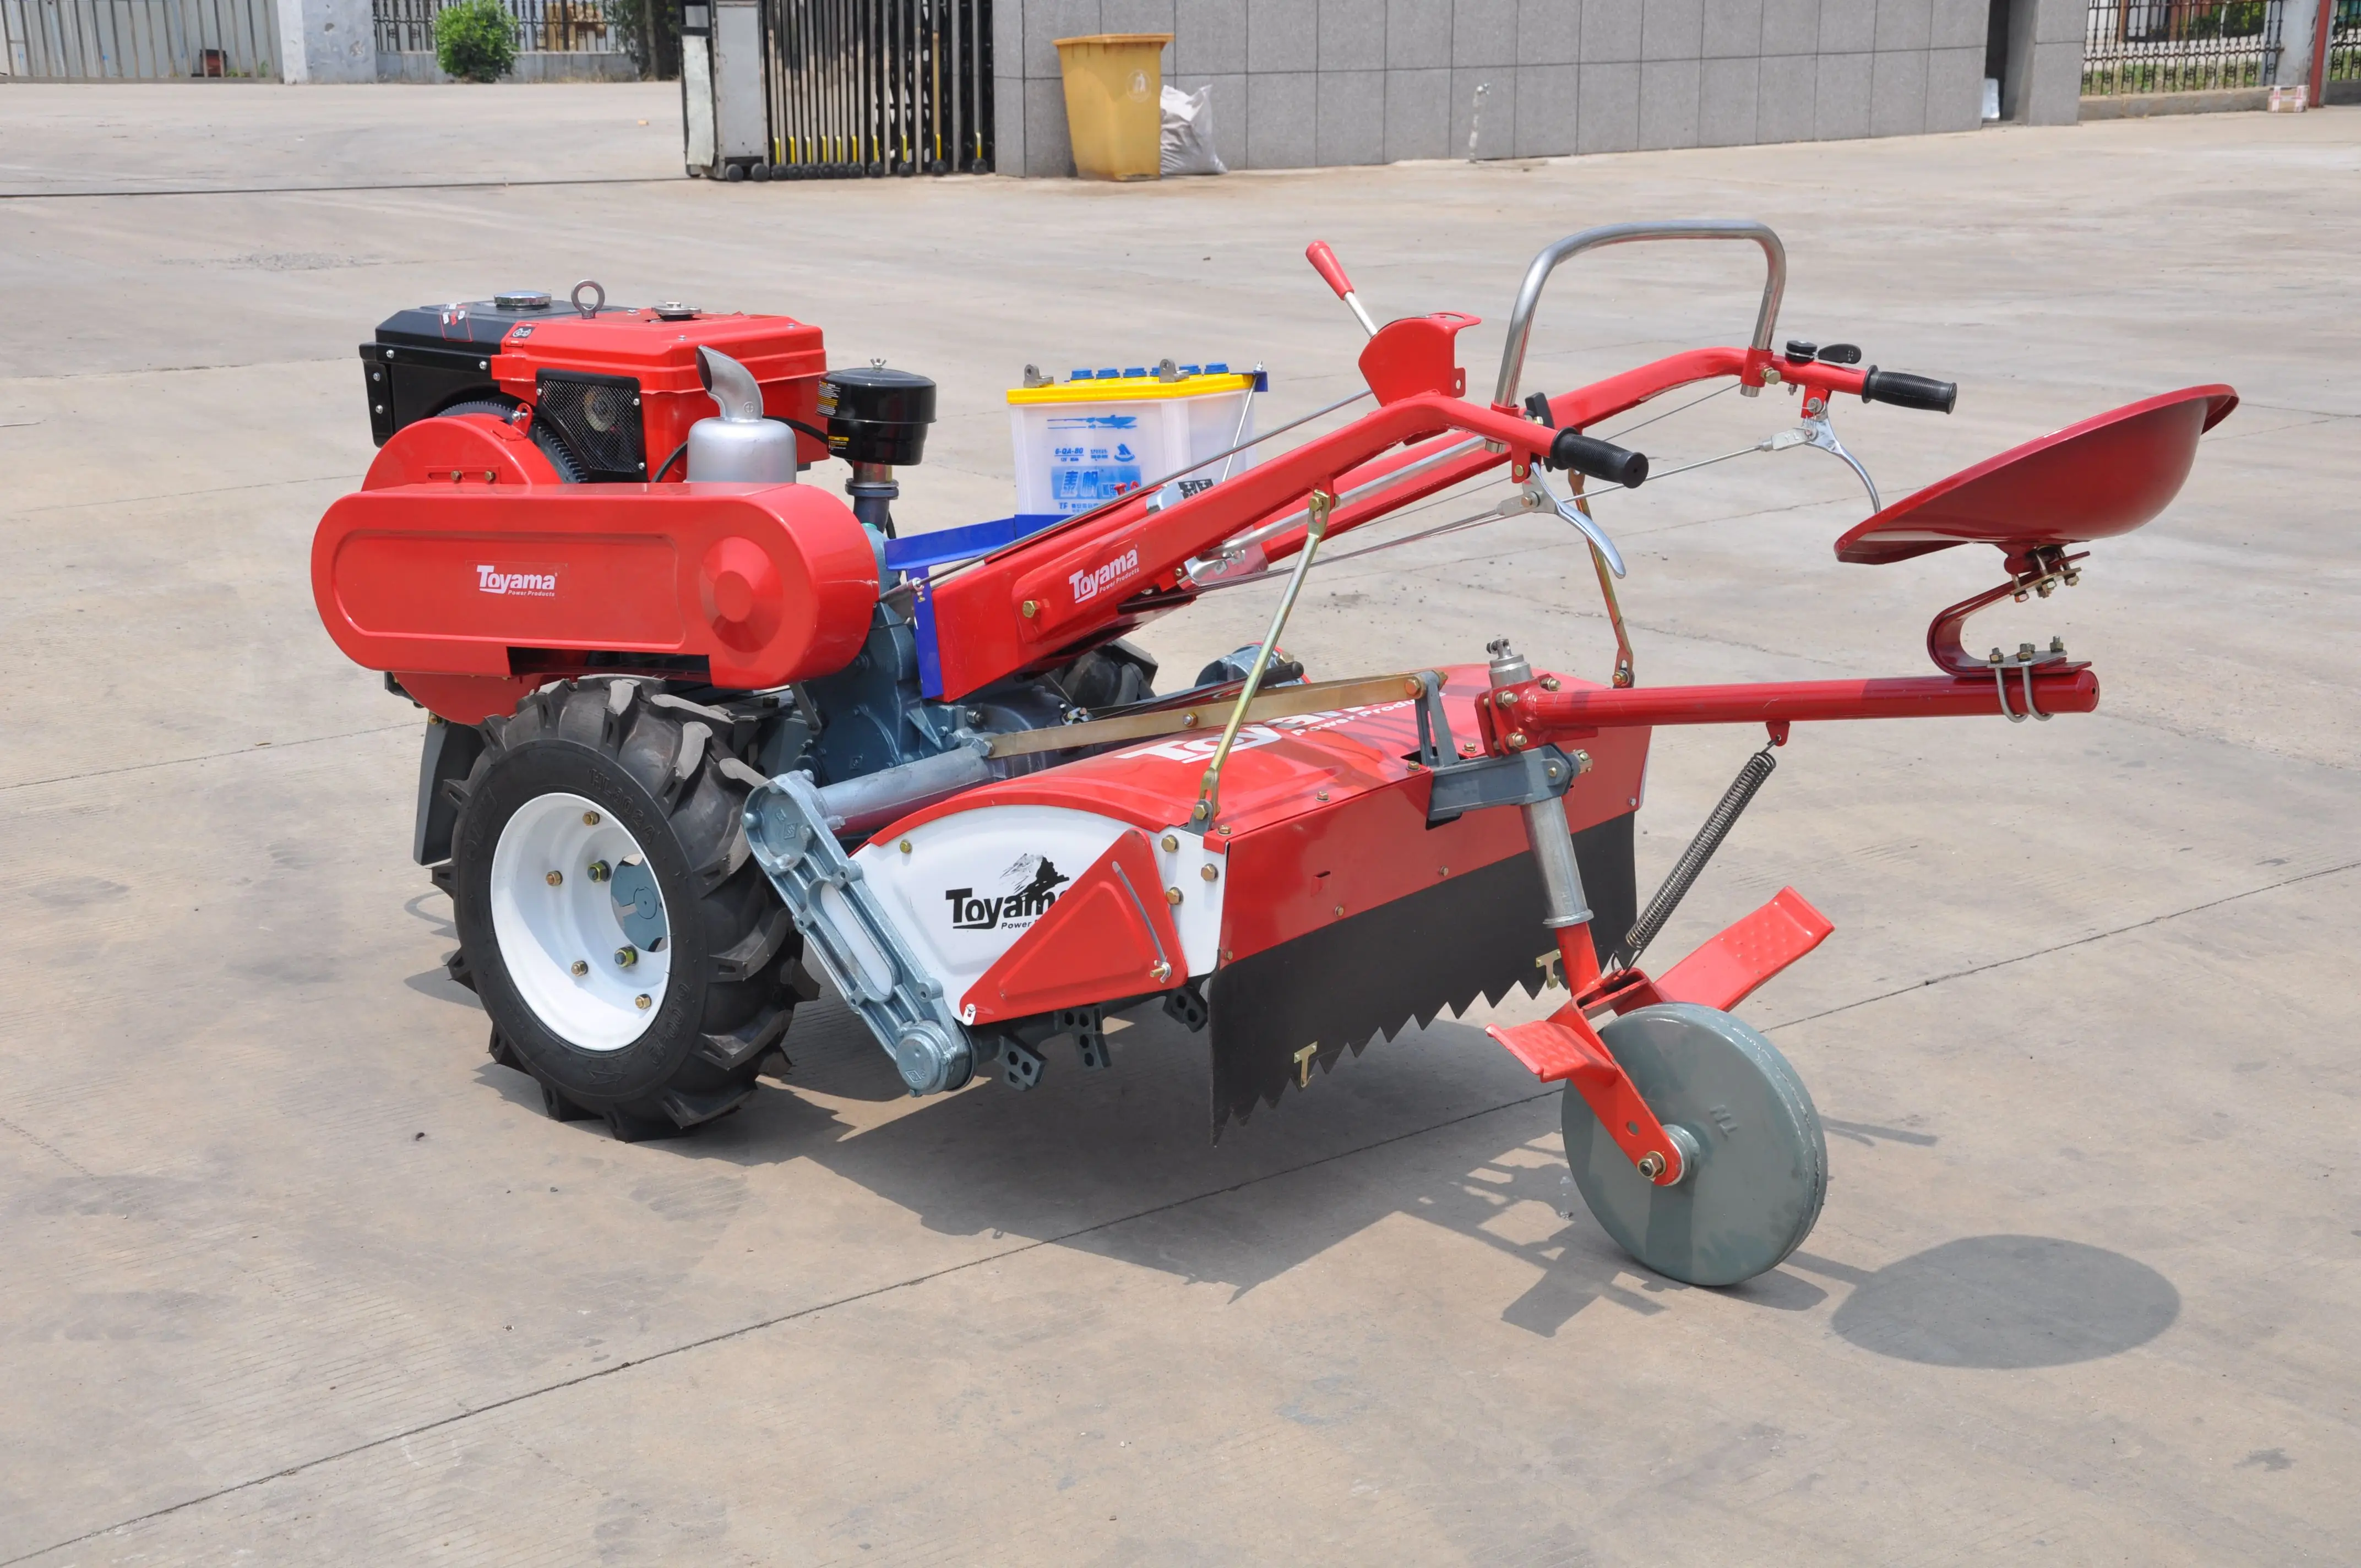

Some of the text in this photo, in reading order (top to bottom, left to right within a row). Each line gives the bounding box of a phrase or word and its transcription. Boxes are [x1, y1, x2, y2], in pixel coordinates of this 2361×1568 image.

[477, 565, 556, 594] Toyama
[1069, 548, 1138, 604] Toyama
[1099, 568, 1140, 594] Power Products
[1291, 716, 1356, 736] Power
[1001, 920, 1032, 929] Power
